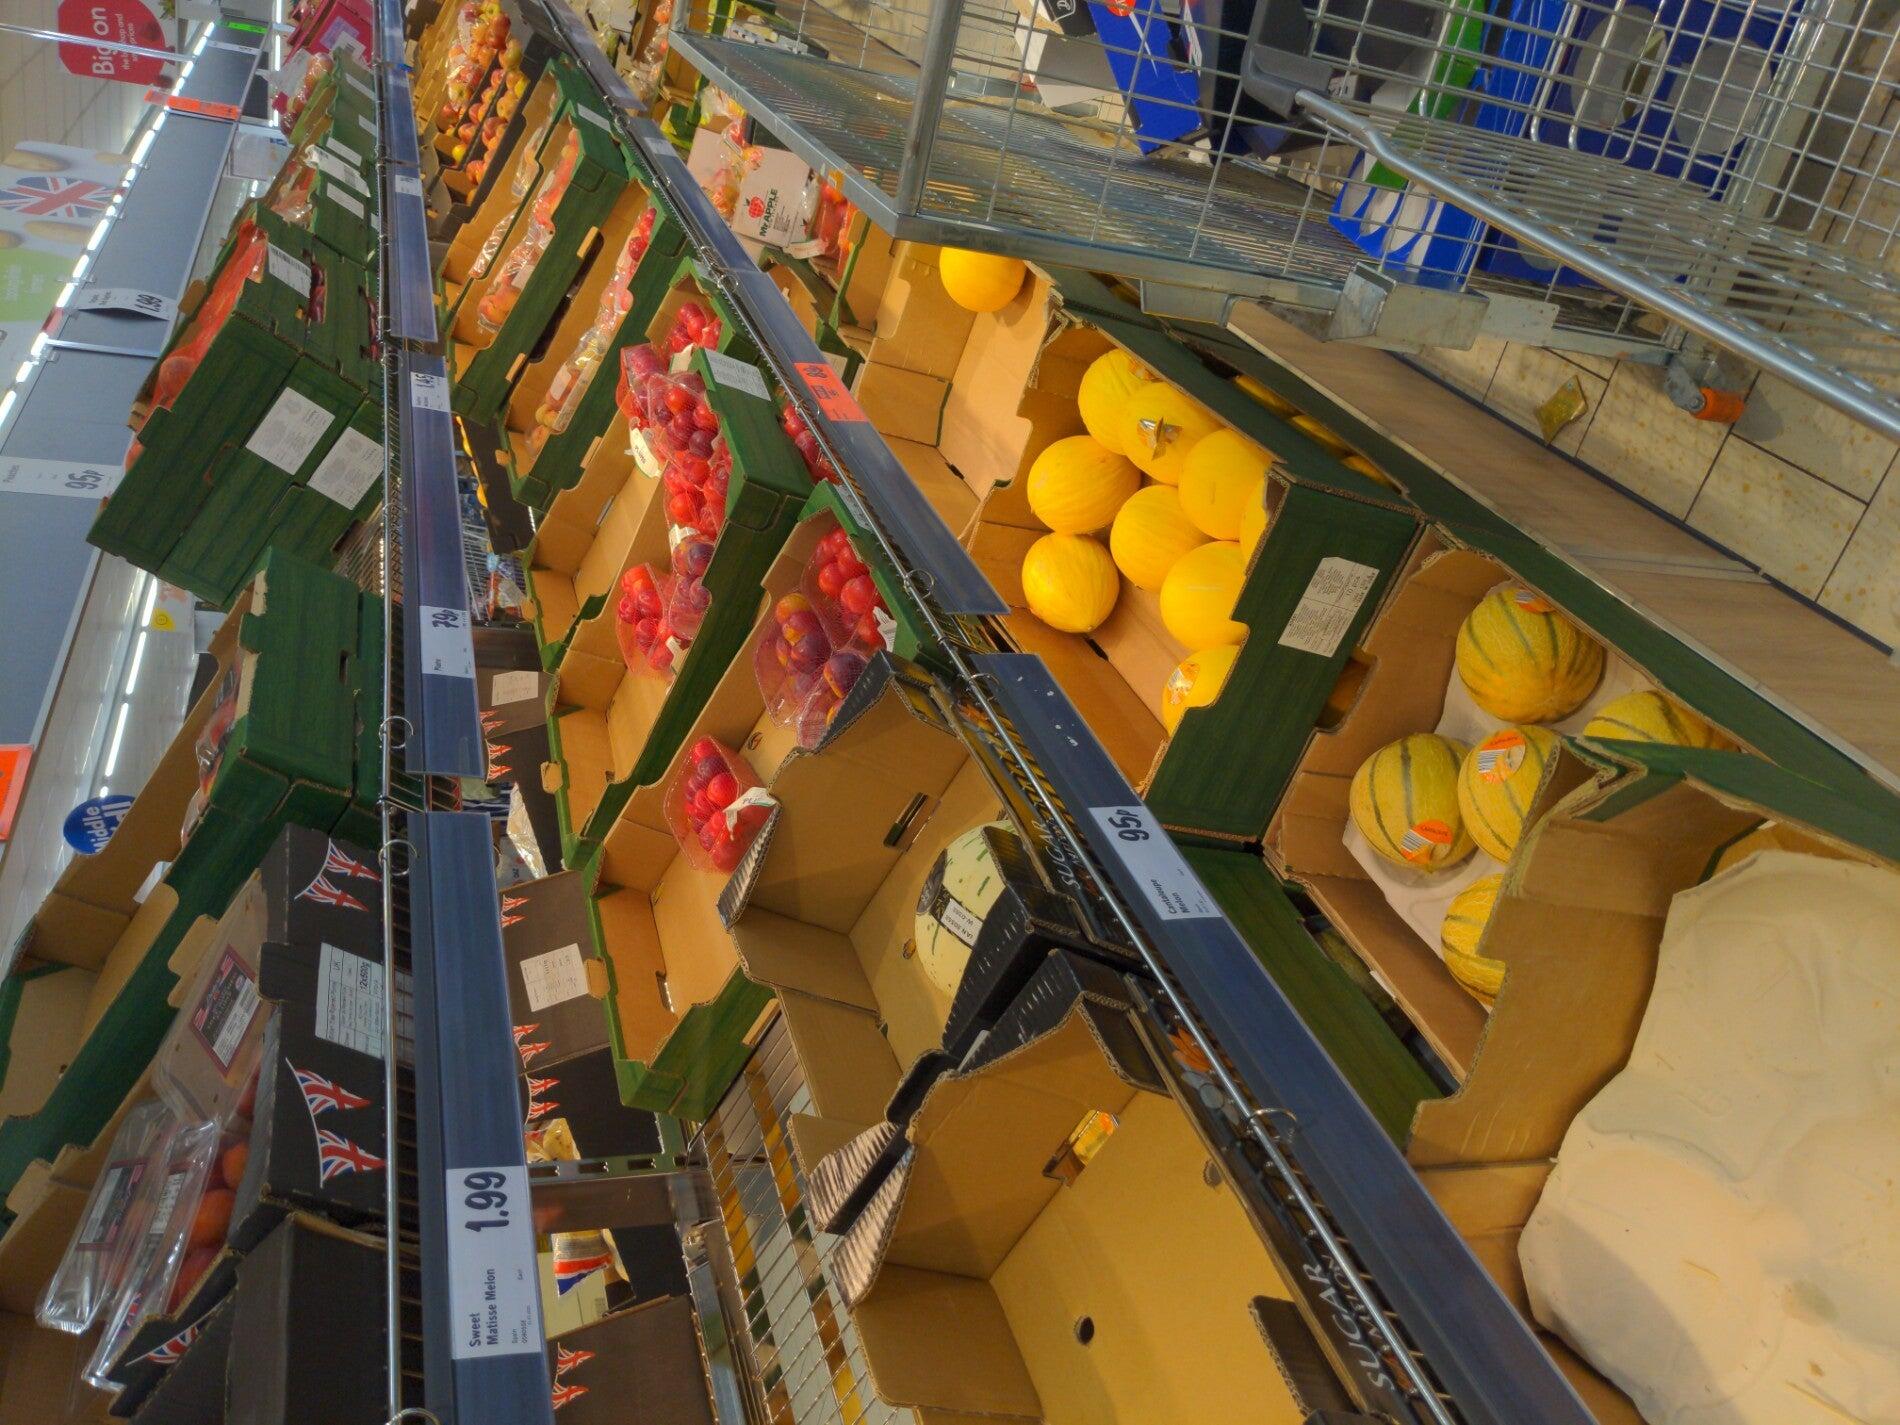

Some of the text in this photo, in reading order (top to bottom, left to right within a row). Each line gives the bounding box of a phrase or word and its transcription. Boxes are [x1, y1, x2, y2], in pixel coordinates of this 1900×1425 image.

[90, 7, 110, 36] on
[114, 13, 126, 28] and
[763, 188, 778, 222] APPLE
[759, 223, 768, 236] Mr
[64, 470, 104, 490] 95p
[1108, 809, 1150, 842] 95p
[1031, 820, 1081, 889] SUGAR
[1150, 879, 1178, 914] Cantaloupe
[1172, 892, 1190, 913] Melon
[464, 1171, 510, 1232] 1.99
[484, 1268, 498, 1346] Matisse Melon
[468, 1312, 482, 1348] Sweet
[1302, 1263, 1395, 1390] SUGAR
